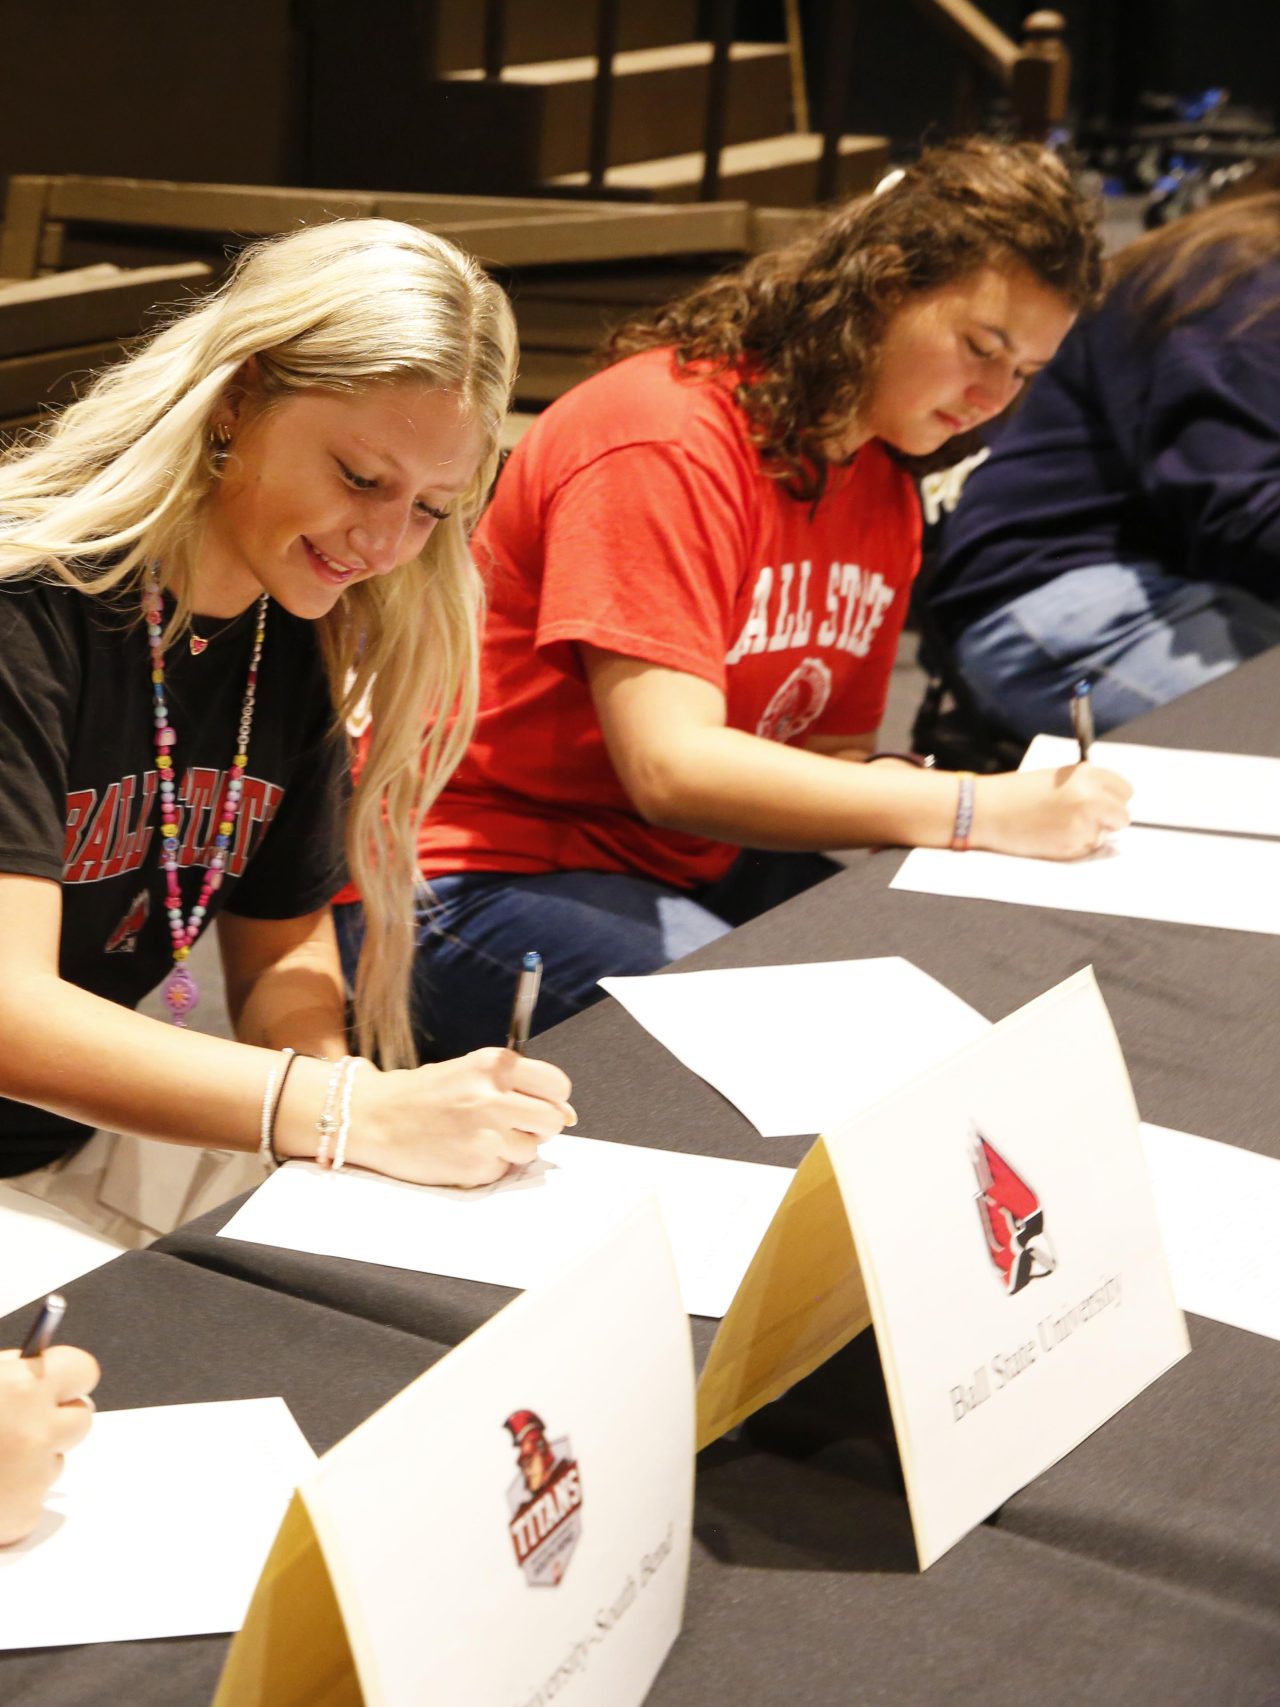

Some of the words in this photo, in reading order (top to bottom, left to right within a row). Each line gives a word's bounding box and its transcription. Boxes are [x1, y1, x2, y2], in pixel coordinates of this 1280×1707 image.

[725, 560, 812, 665] ALL
[949, 1384, 992, 1423] Ball
[991, 1340, 1037, 1390] State
[1037, 1274, 1122, 1353] University
[510, 1467, 581, 1559] TITANS
